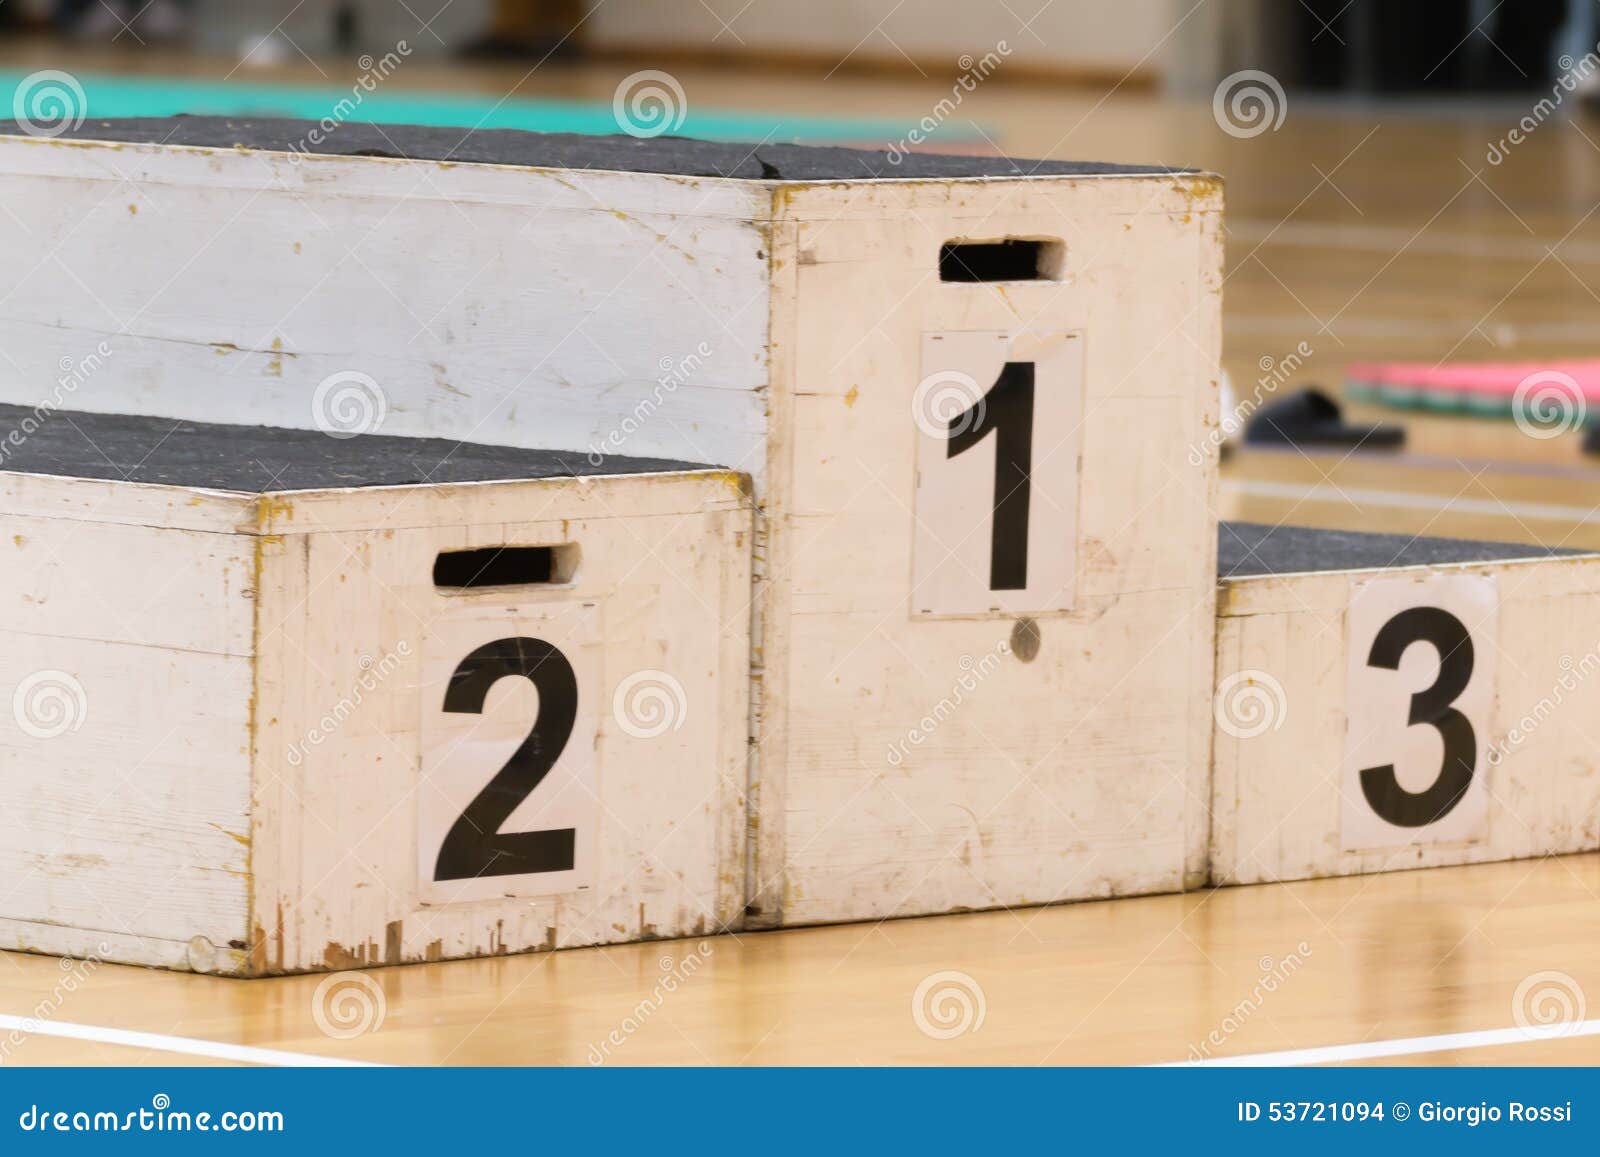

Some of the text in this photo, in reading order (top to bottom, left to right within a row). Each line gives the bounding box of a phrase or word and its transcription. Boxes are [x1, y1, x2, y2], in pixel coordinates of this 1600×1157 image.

[947, 361, 1035, 591] 1
[434, 636, 578, 882] 2
[1360, 606, 1477, 828] 3
